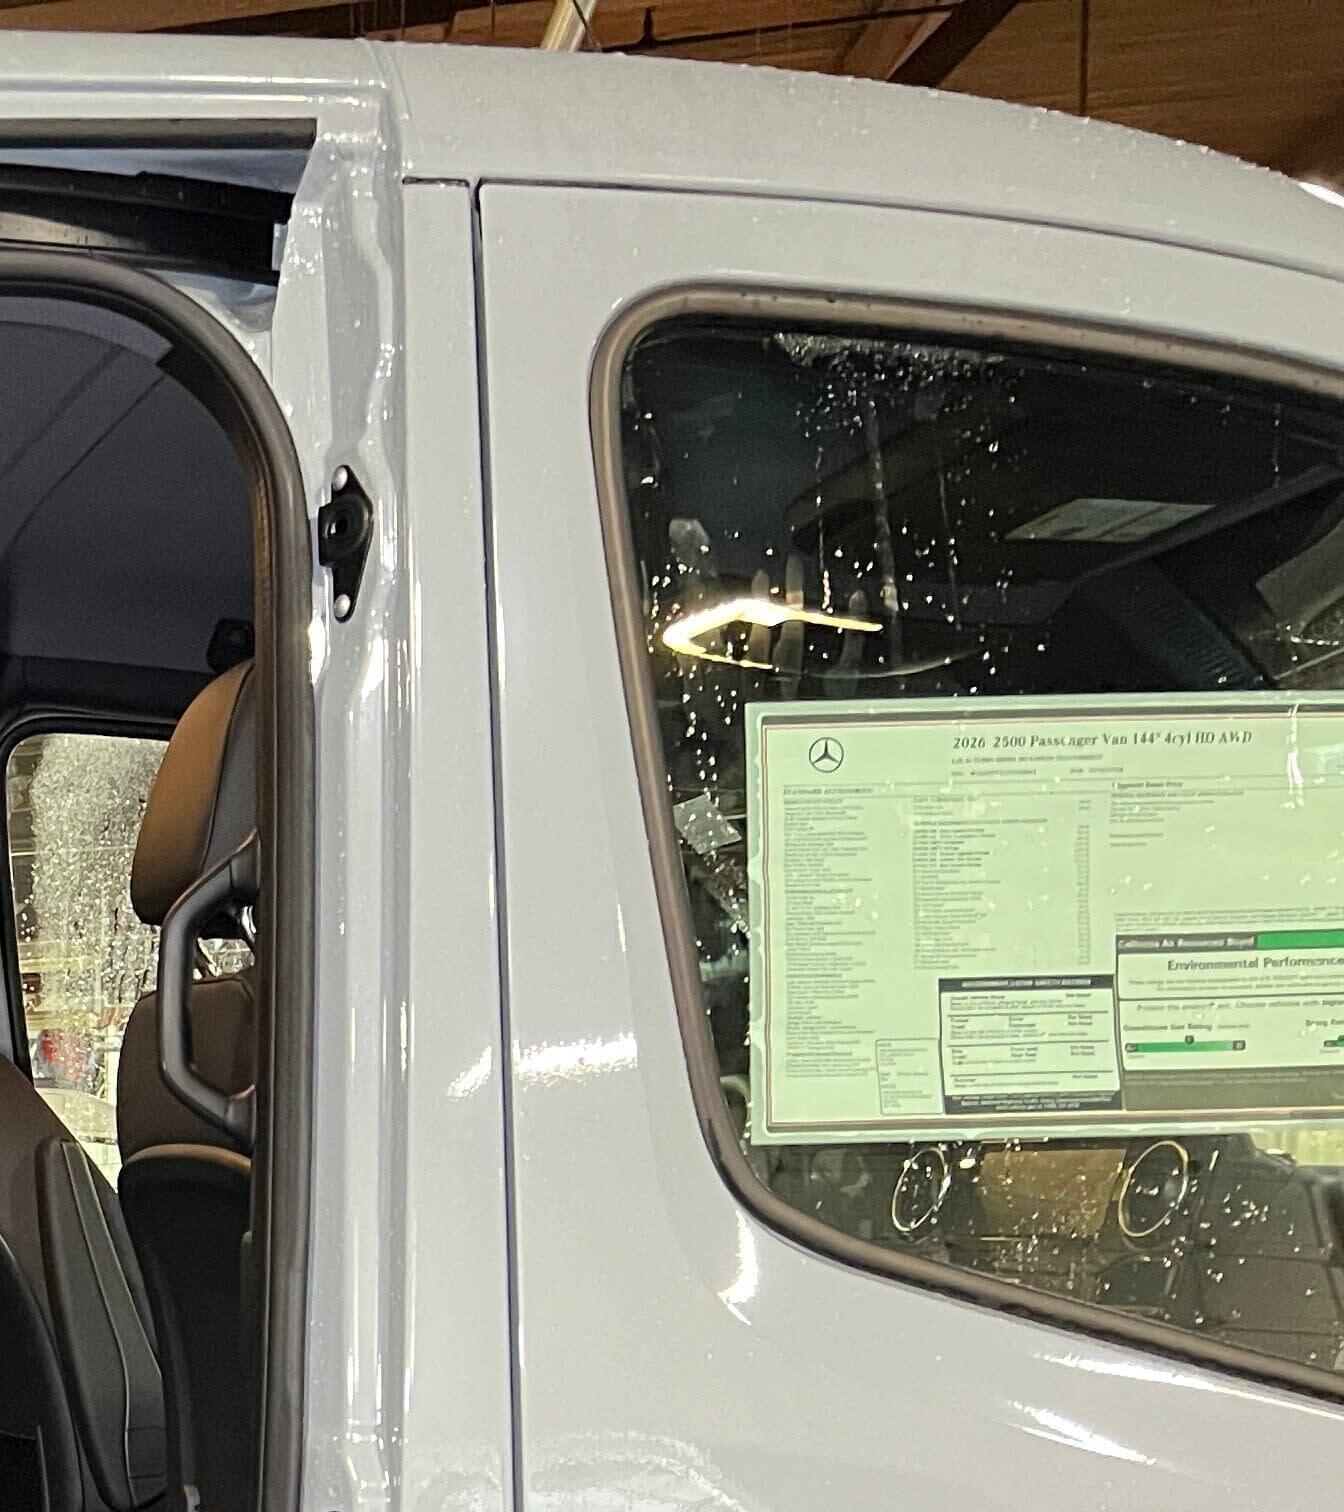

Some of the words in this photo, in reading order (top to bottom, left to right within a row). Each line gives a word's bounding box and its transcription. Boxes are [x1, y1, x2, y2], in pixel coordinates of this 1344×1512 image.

[953, 737, 986, 749] 2026
[993, 736, 1026, 748] 2500
[1102, 733, 1128, 745] Van
[1168, 958, 1259, 971] Environmental
[1263, 957, 1344, 969] Performance
